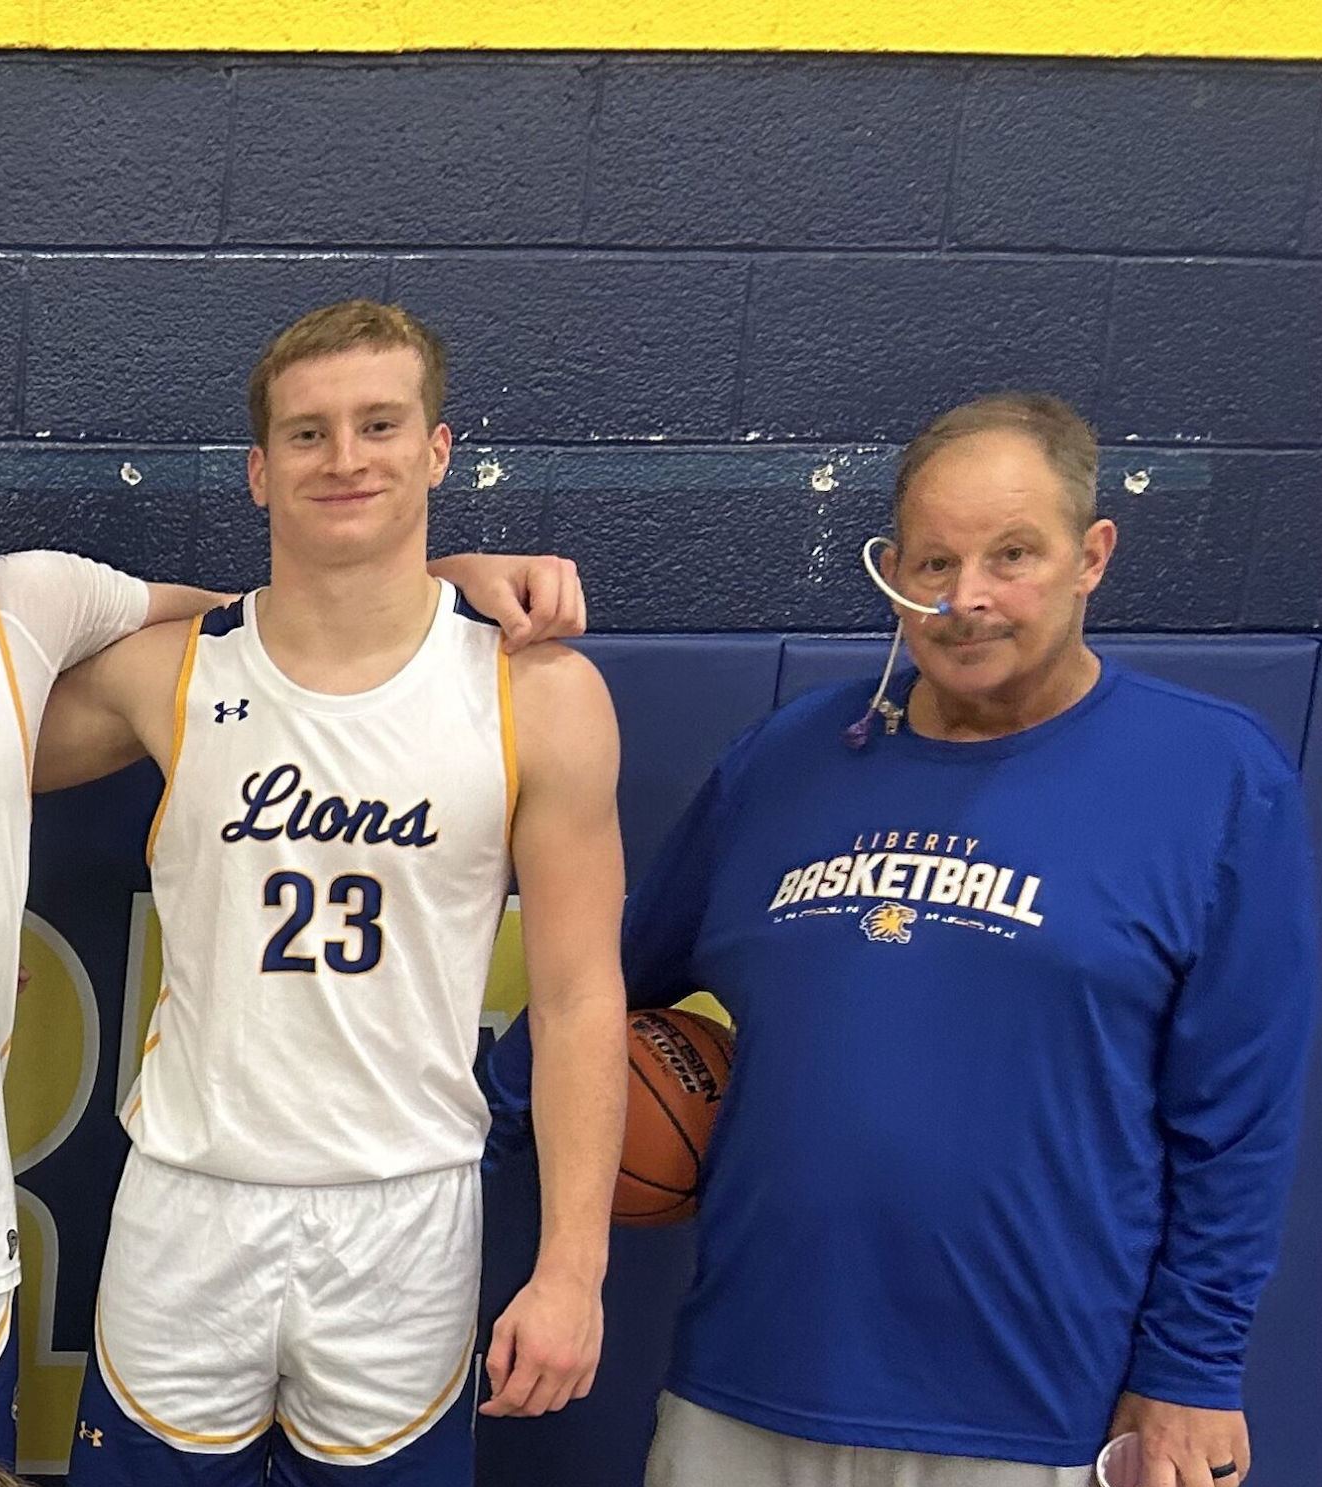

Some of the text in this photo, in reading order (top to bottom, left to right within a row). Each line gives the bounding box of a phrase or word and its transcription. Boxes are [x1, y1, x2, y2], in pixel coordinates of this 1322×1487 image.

[221, 764, 438, 848] Lions
[853, 831, 979, 857] LIBERTY
[260, 870, 384, 974] 23
[768, 853, 1044, 927] BASKETBALL
